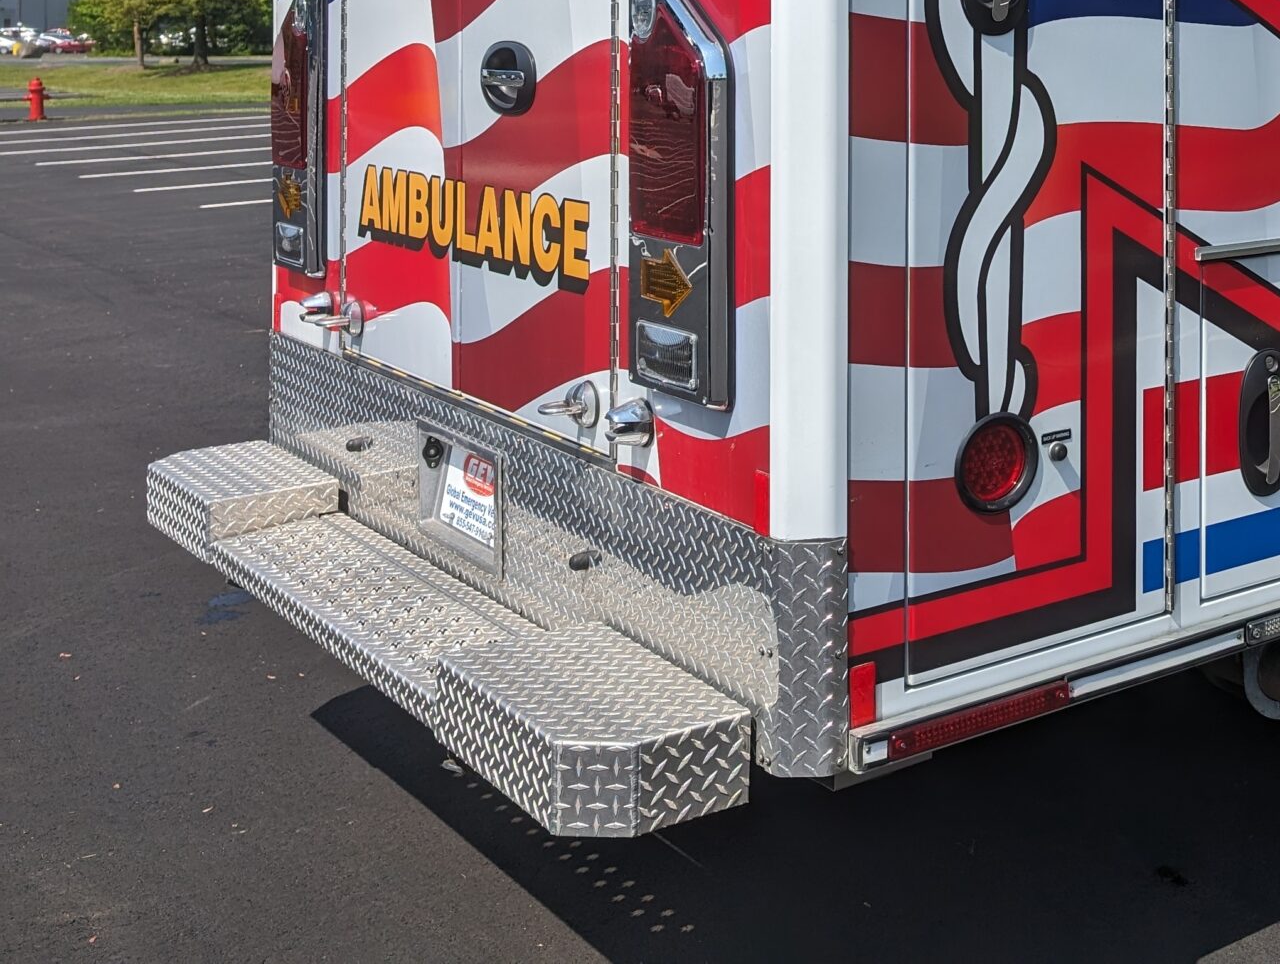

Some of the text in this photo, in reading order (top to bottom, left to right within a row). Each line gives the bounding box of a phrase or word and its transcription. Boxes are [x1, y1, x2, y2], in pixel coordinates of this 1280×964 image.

[358, 164, 590, 294] AMBULANCE
[446, 483, 462, 500] Global
[461, 491, 487, 515] Emergency
